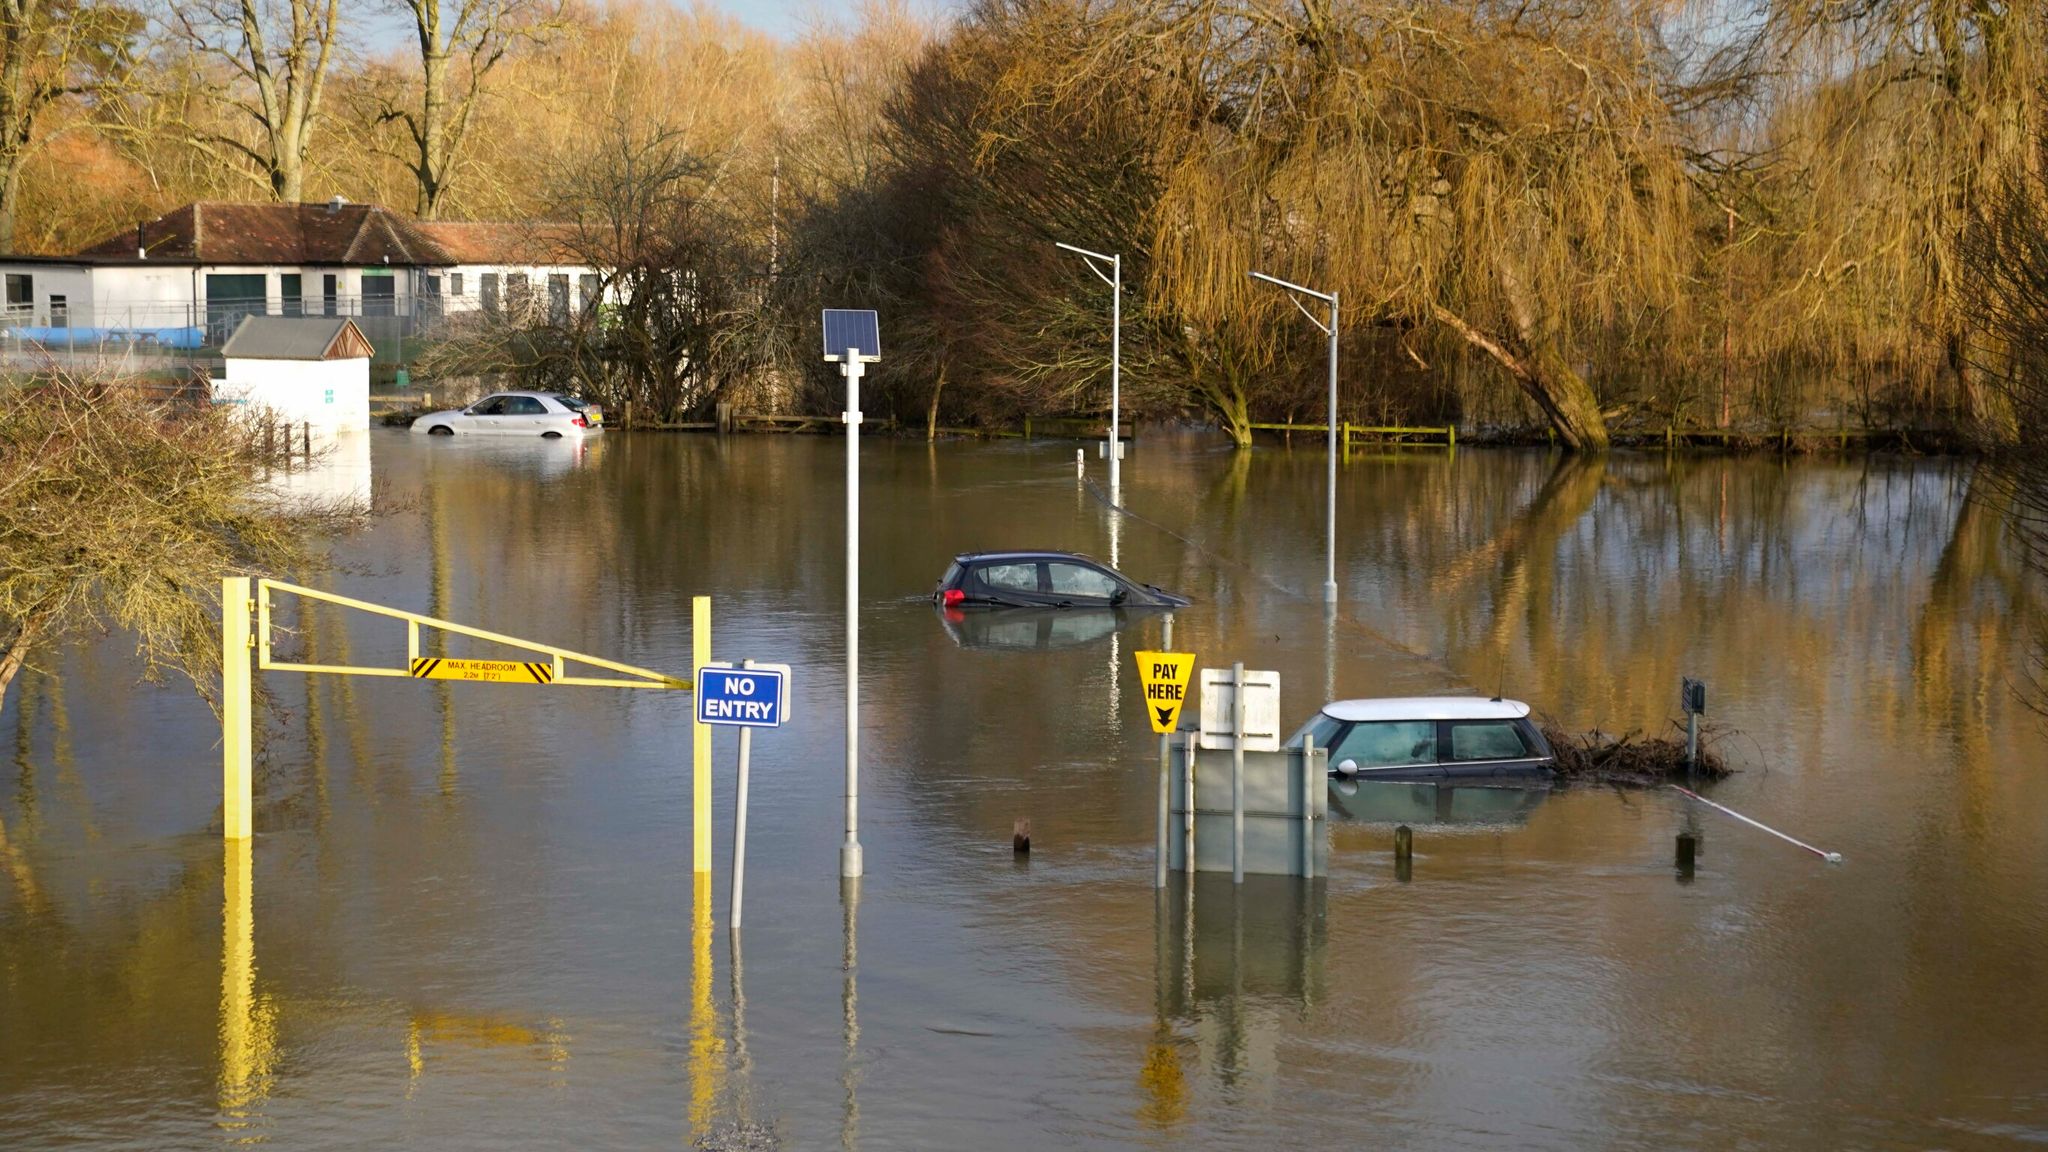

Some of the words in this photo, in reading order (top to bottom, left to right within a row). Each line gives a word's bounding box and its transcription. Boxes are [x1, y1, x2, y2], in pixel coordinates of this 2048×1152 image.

[470, 662, 517, 671] HEADROOM
[1153, 664, 1178, 680] PAY
[725, 678, 755, 695] NO
[1148, 684, 1183, 700] HERE
[705, 699, 773, 719] ENTRY
